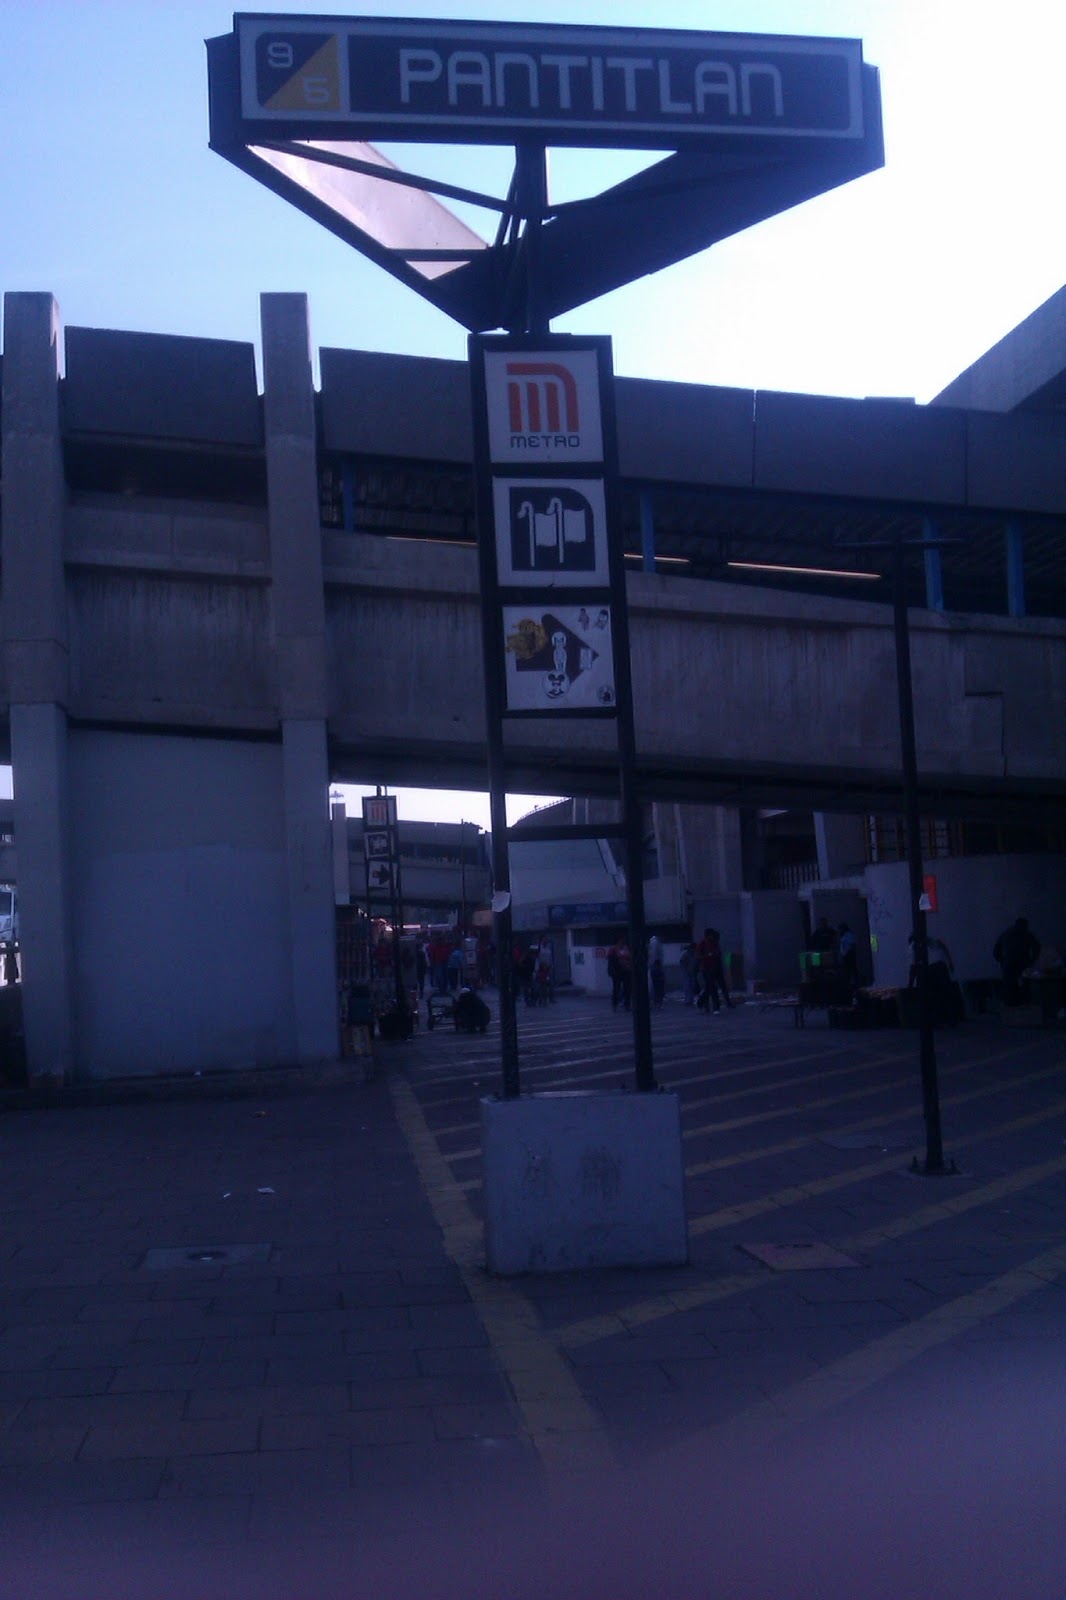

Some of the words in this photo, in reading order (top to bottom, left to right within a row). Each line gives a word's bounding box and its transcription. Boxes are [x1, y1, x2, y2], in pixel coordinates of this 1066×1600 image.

[266, 41, 294, 69] 9
[400, 48, 784, 117] PANTITLAN
[510, 435, 580, 448] METRO
